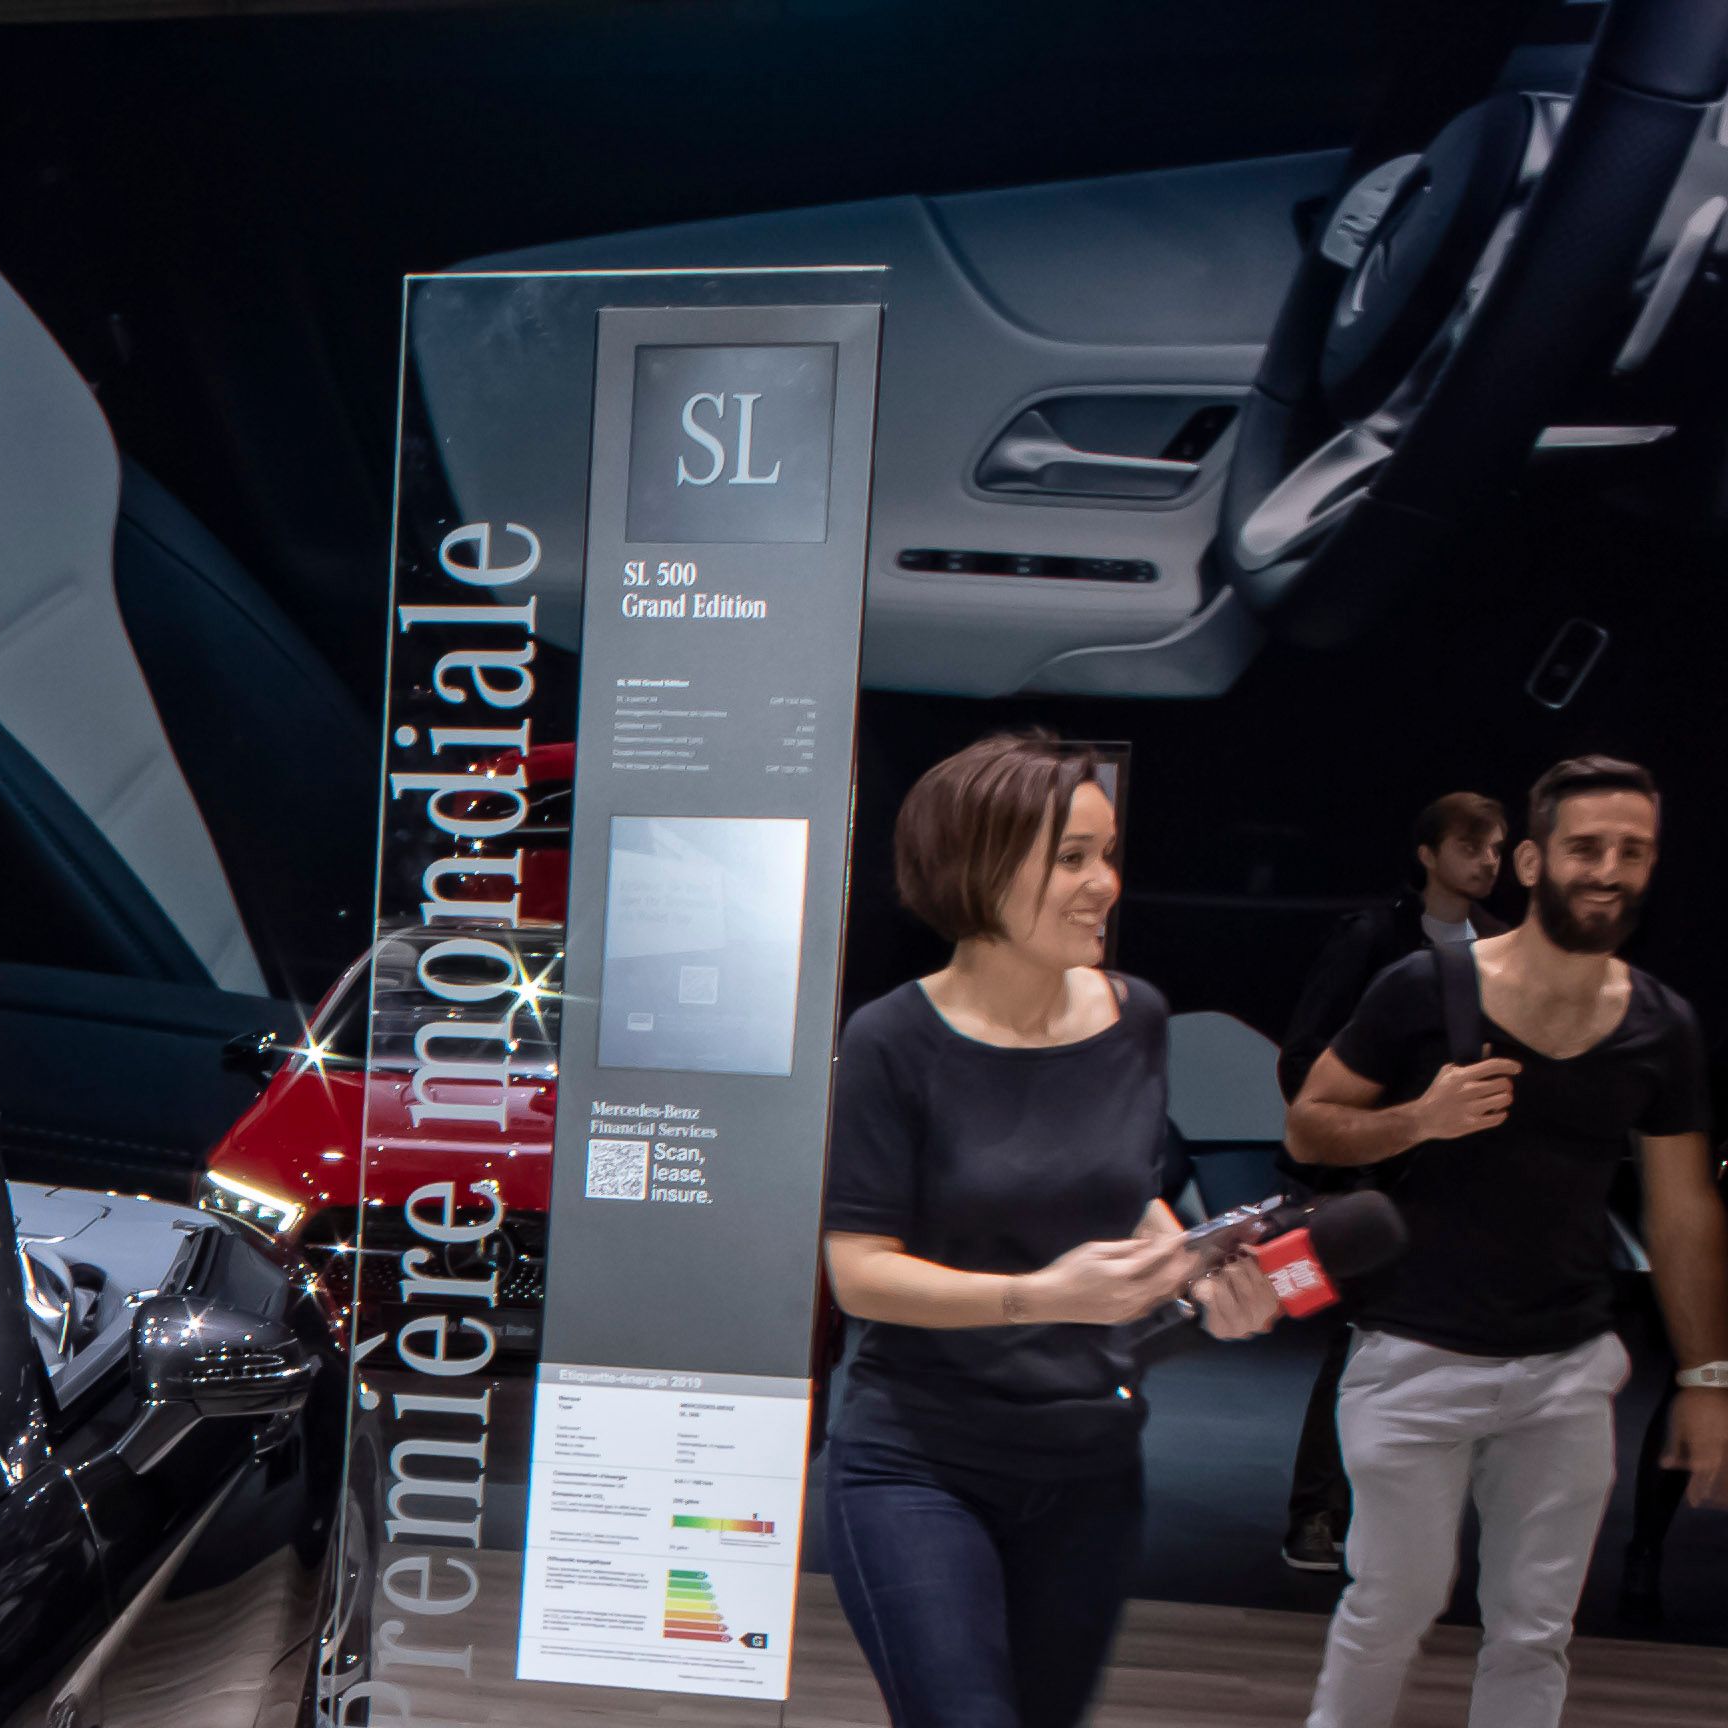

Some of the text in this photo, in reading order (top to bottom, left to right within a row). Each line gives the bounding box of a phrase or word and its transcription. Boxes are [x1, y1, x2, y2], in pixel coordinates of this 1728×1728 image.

[676, 392, 782, 487] SL
[622, 560, 698, 587] SL 500
[621, 592, 767, 619] Grand Edition
[392, 521, 543, 1132] mondiale
[591, 1100, 701, 1120] Mercedes-Benz
[590, 1119, 718, 1138] Financial Services
[654, 1142, 706, 1165] Scan,
[652, 1163, 706, 1186] lease,
[651, 1183, 713, 1204] insure.
